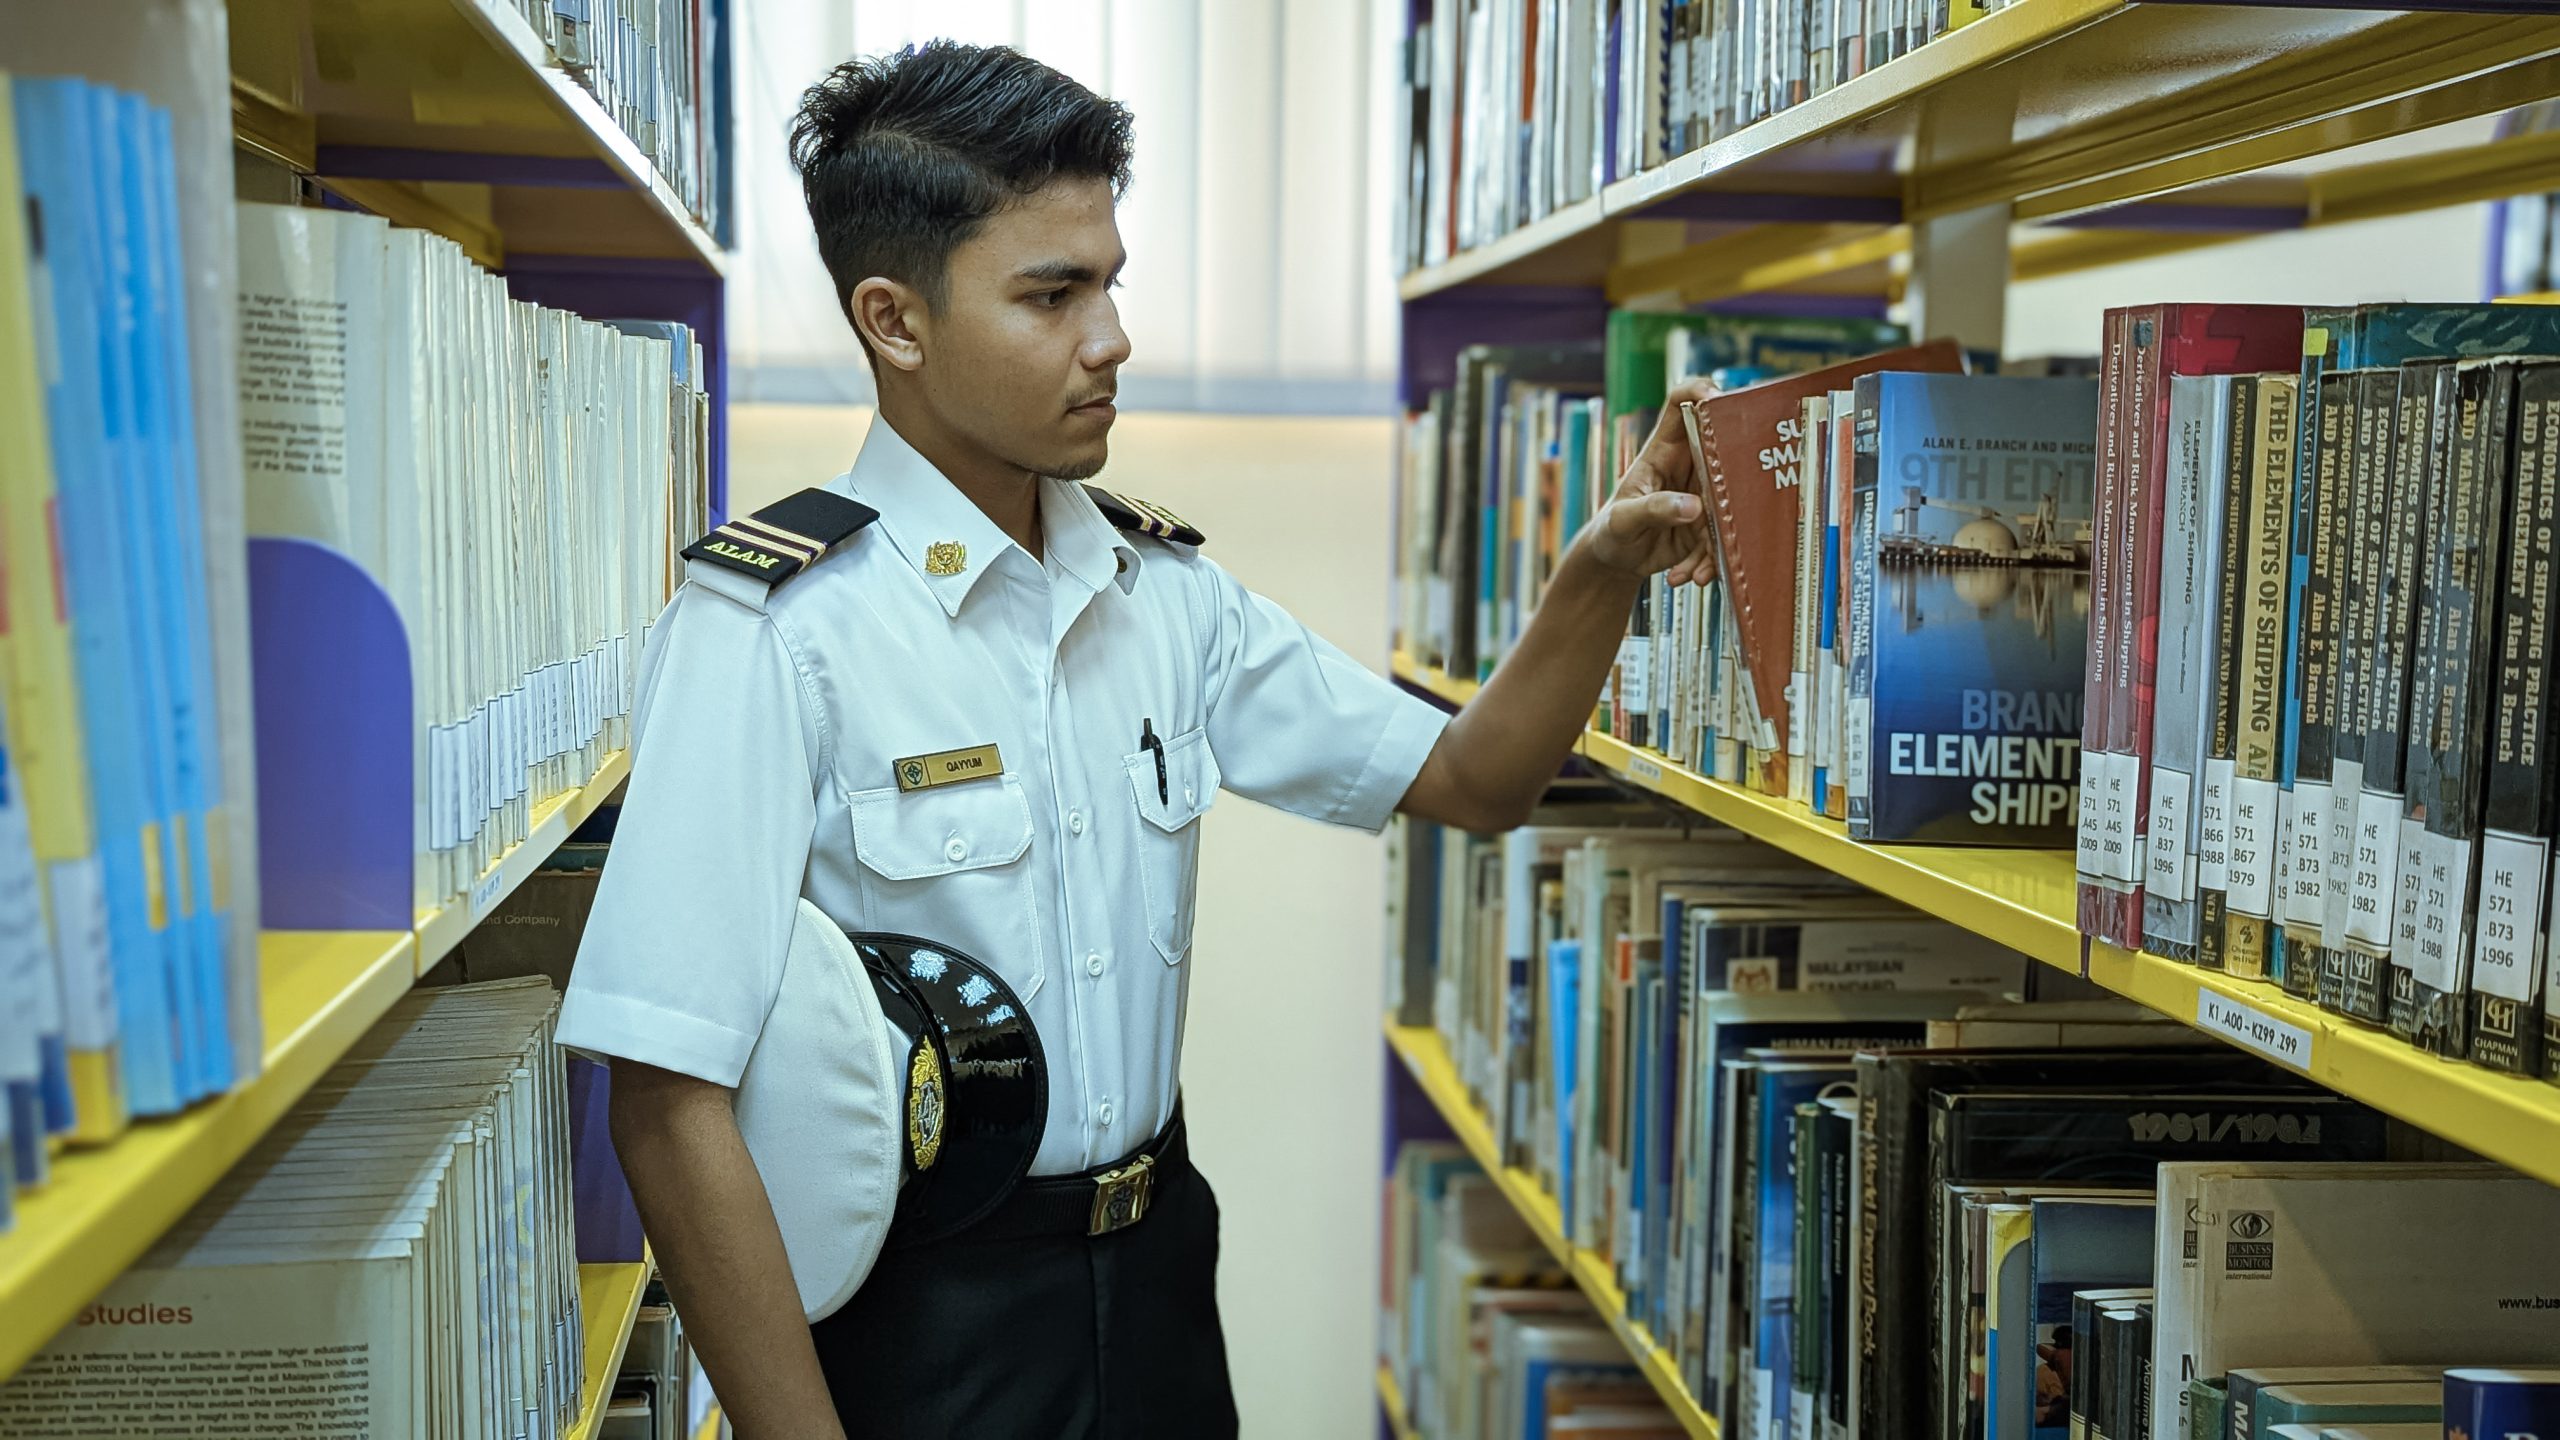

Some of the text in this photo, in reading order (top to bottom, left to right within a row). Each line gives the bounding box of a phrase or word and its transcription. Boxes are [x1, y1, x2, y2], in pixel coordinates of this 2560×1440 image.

[2434, 403, 2446, 445] AND
[2461, 399, 2477, 441] AND
[1922, 437, 2096, 455] ALAN E. BRANCH AND MICH
[2131, 431, 2141, 459] and
[2300, 379, 2316, 514] MANAGEMENT
[1901, 453, 1989, 502] 9TH
[2129, 463, 2140, 497] Risk
[2178, 421, 2191, 532] ALAN BRANCH
[2094, 343, 2121, 682] Derivatives and Risk Management in Shipping
[2184, 420, 2201, 605] ELEMENTS OF SHIPPING
[2424, 450, 2443, 591] MANAGEMENT
[2451, 447, 2474, 591] MANAGEMENT
[2219, 384, 2247, 682] ECONOMICS OF SHIPPING PRACTICE AND
[703, 540, 780, 569] ALAM
[2124, 502, 2138, 597] Management
[2250, 390, 2291, 733] THE ELEMENTS OF SHIPPING
[2305, 404, 2338, 725] AND MANAGEMENT Alan E. Branch
[2323, 403, 2354, 727] ECONOMICS OF SHIPPING PRACTICE
[2340, 407, 2373, 734] AND MANAGEMENT Alan E. Branch
[2355, 406, 2390, 737] ECONOMICS OF SHIPPING PRACTICE
[2371, 396, 2412, 731] AND MANAGEMENT Alan E. Branch
[2386, 394, 2428, 734] ECONOMICS OF SHIPPING PRACTICE
[2498, 400, 2540, 763] AND MANAGEMENT Alan E. Branch
[2520, 400, 2560, 767] ECONOMICS OF SHIPPING PRACTICE
[1861, 573, 1872, 657] ELEMENTS
[2123, 601, 2132, 616] in
[1852, 582, 1863, 657] SHIPPING
[2419, 604, 2431, 648] Alan
[2446, 605, 2462, 651] Alan
[2119, 621, 2132, 689] Shipping
[2416, 655, 2427, 673] E.
[2444, 658, 2458, 677] E.
[2411, 681, 2425, 745] Branch
[2439, 684, 2456, 752] Branch
[946, 756, 983, 773] QAYYUM
[1889, 732, 2081, 781] ELEMENT
[2086, 777, 2096, 790] HE
[2110, 778, 2121, 792] HE
[2206, 784, 2220, 799] HE
[2083, 797, 2097, 811] 571
[2107, 799, 2121, 813] 571
[2161, 795, 2174, 810] HE
[2238, 803, 2254, 819] HE
[2334, 795, 2349, 812] HE
[2204, 806, 2222, 821] 571
[2302, 811, 2317, 827] HE
[2081, 818, 2098, 831] .A45
[2105, 819, 2122, 834] .A45
[2158, 817, 2174, 832] 571
[2233, 825, 2255, 842] 571
[2333, 823, 2349, 841] 571
[2363, 823, 2378, 840] HE
[2080, 837, 2098, 851] 2009
[2155, 837, 2174, 852] .B37
[2202, 828, 2224, 843] .B66
[2298, 834, 2318, 850] 571
[2103, 839, 2122, 855] 2009
[2230, 848, 2256, 865] .B67
[2359, 846, 2377, 865] 571
[2153, 857, 2174, 874] 1996
[2200, 850, 2225, 865] 1988
[2296, 857, 2320, 874] .B73
[2329, 850, 2350, 869] .B73
[2408, 849, 2421, 866] HE
[2228, 869, 2255, 886] 1979
[2355, 871, 2378, 889] .B73
[2405, 873, 2421, 892] 571
[2432, 863, 2446, 883] HE
[2494, 869, 2513, 889] HE
[2294, 880, 2321, 898] 1982
[2327, 877, 2348, 896] 1982
[2351, 894, 2376, 914] 1982
[2428, 888, 2445, 909] 571
[2488, 894, 2513, 915] 571
[504, 913, 561, 927] Company
[2424, 914, 2443, 934] .B73
[2484, 920, 2514, 942] .B73
[2420, 938, 2443, 961] 1988
[2481, 946, 2514, 969] 1996
[1806, 959, 1905, 975] MALAYSIAN
[2207, 1001, 2220, 1022] K1
[2221, 1009, 2243, 1033] .A00
[2251, 1021, 2275, 1046] KZ99
[2276, 1033, 2298, 1055] .Z99
[2474, 1036, 2518, 1058] CHAPMAN
[2479, 1050, 2511, 1067] & HALL
[1862, 1097, 1878, 1356] The World Energy Book
[2228, 1243, 2273, 1255] BUSINESS
[2228, 1257, 2272, 1270] MONITOR
[77, 1302, 193, 1327] Studies
[2142, 1358, 2152, 1428] Maritime
